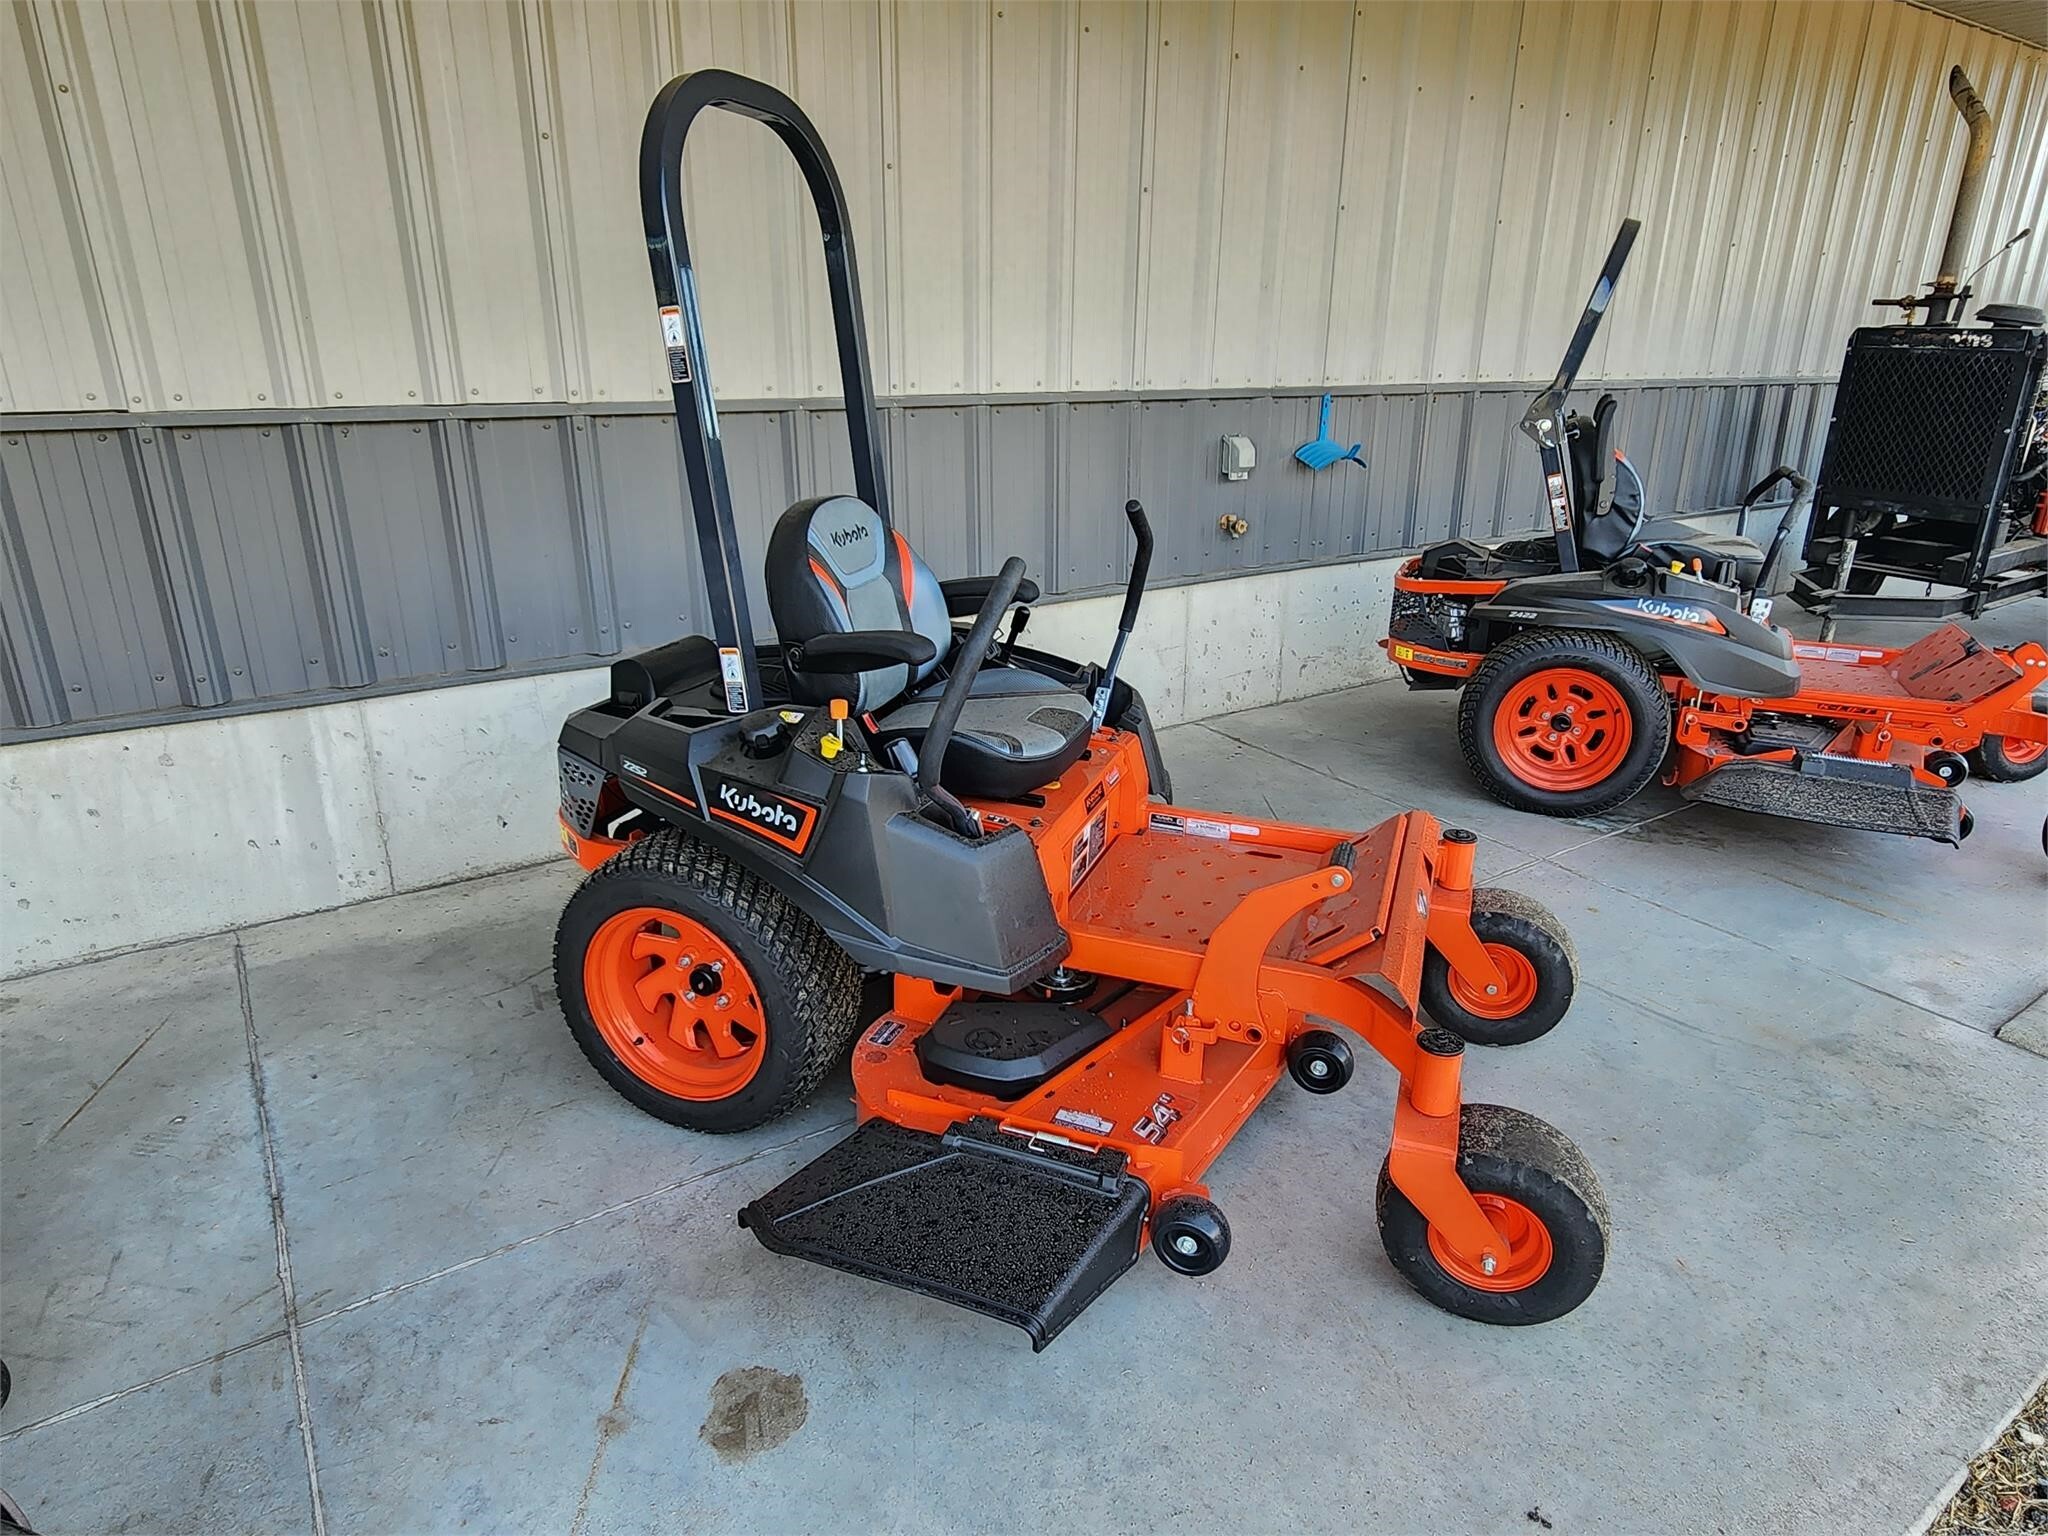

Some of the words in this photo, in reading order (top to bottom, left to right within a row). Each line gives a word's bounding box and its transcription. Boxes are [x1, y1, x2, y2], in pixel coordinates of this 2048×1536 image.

[830, 523, 868, 548] Kubota
[1637, 598, 1699, 622] Kubota
[719, 783, 798, 832] Kubota
[1132, 1092, 1181, 1146] 54"
